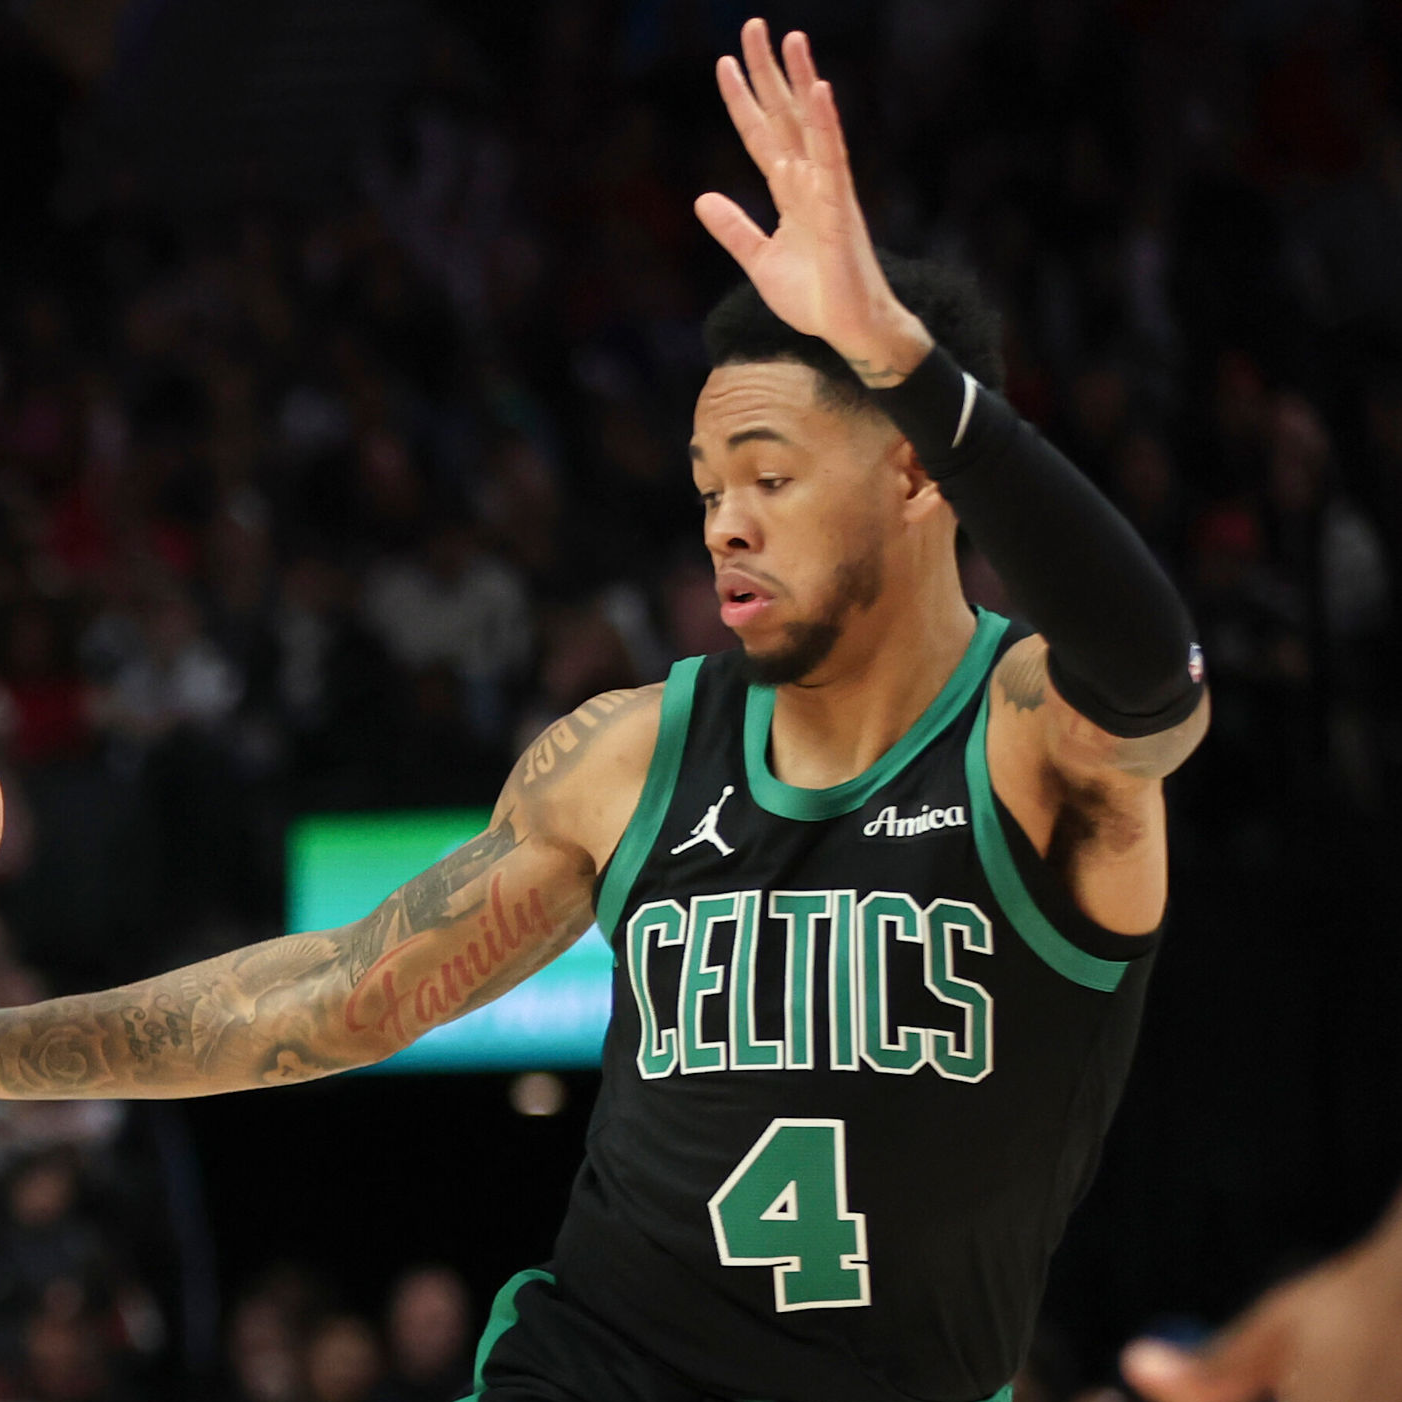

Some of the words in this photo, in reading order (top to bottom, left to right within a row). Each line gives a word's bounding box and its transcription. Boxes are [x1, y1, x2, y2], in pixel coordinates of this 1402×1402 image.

[863, 804, 967, 837] Amica
[626, 889, 994, 1084] CELTICS
[707, 1117, 872, 1313] 4
